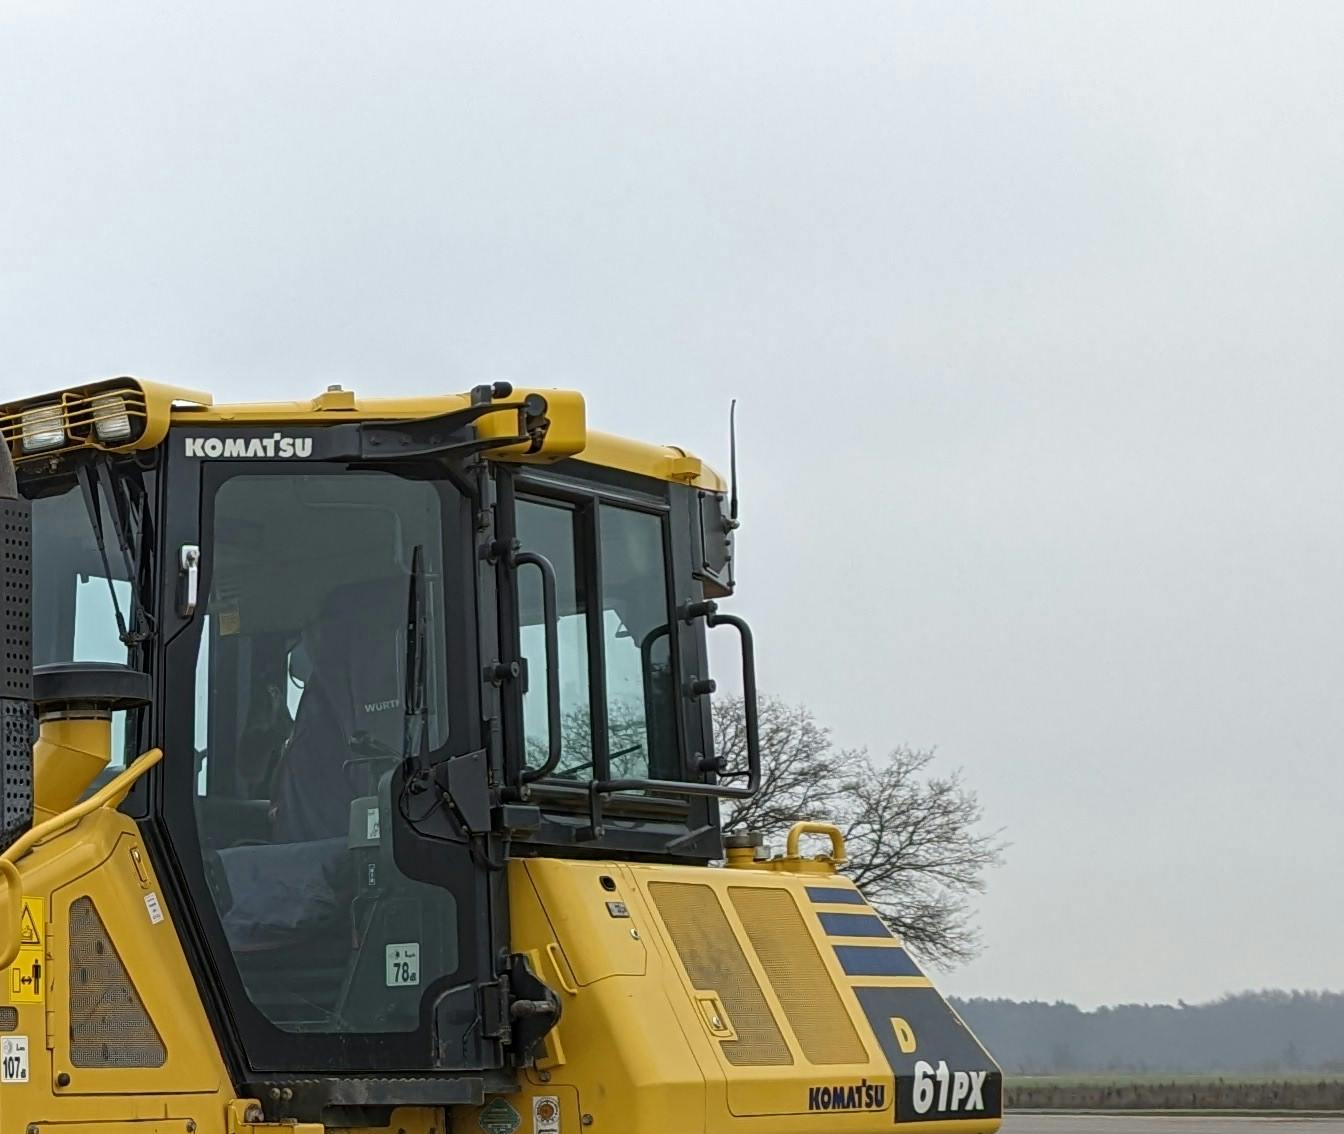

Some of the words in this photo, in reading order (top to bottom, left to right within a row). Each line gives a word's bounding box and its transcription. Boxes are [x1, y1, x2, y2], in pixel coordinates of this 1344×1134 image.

[185, 432, 312, 458] KOMATSU
[393, 961, 410, 983] 78
[889, 1016, 917, 1053] D
[3, 1056, 21, 1079] 107
[808, 1078, 885, 1110] KOMATSU
